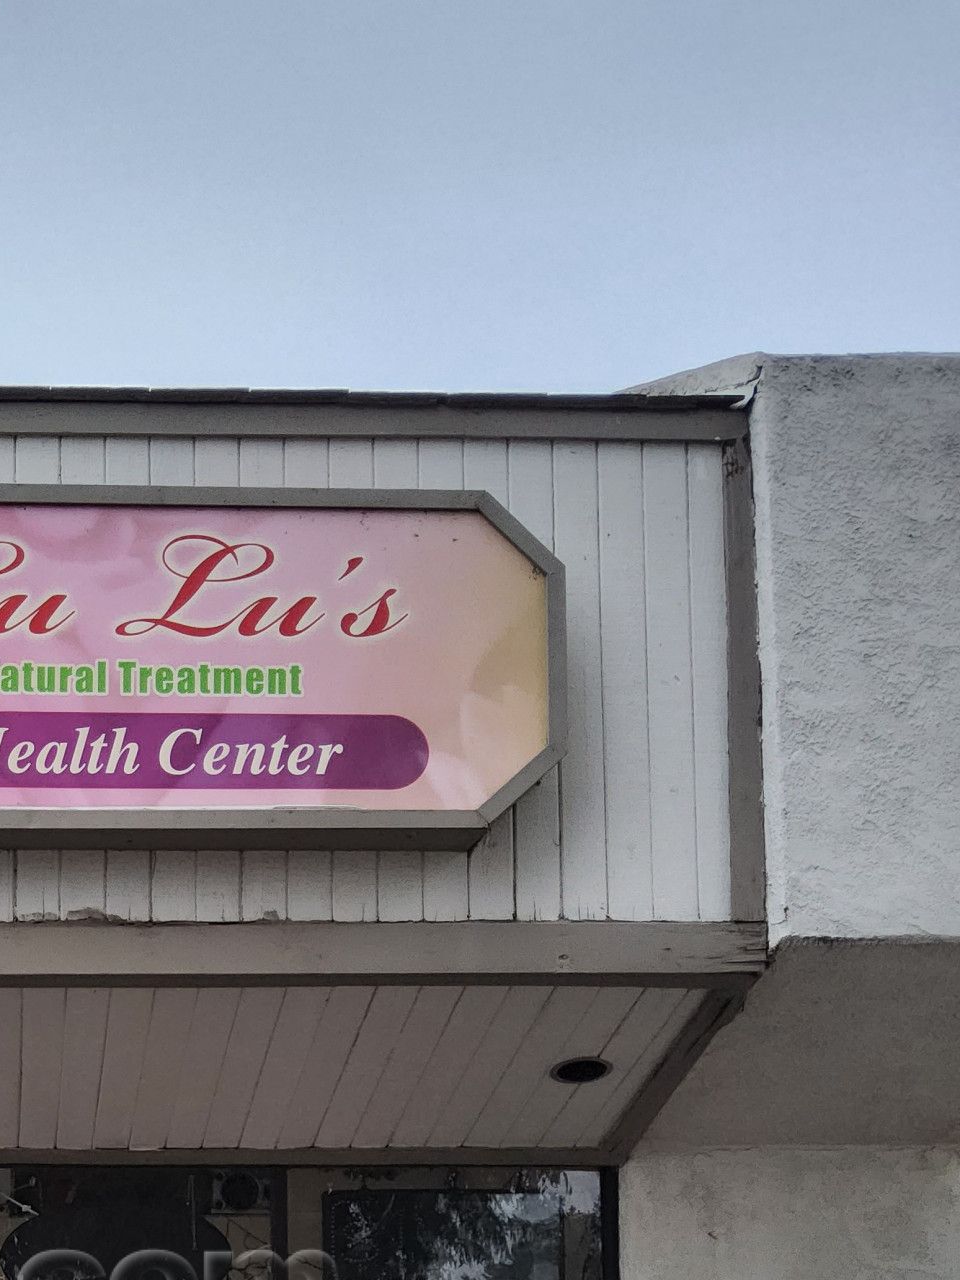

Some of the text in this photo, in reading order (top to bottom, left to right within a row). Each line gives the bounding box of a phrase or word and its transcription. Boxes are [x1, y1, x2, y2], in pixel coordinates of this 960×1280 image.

[115, 534, 408, 638] Lu's
[118, 661, 301, 695] Treatment
[158, 727, 344, 777] Center
